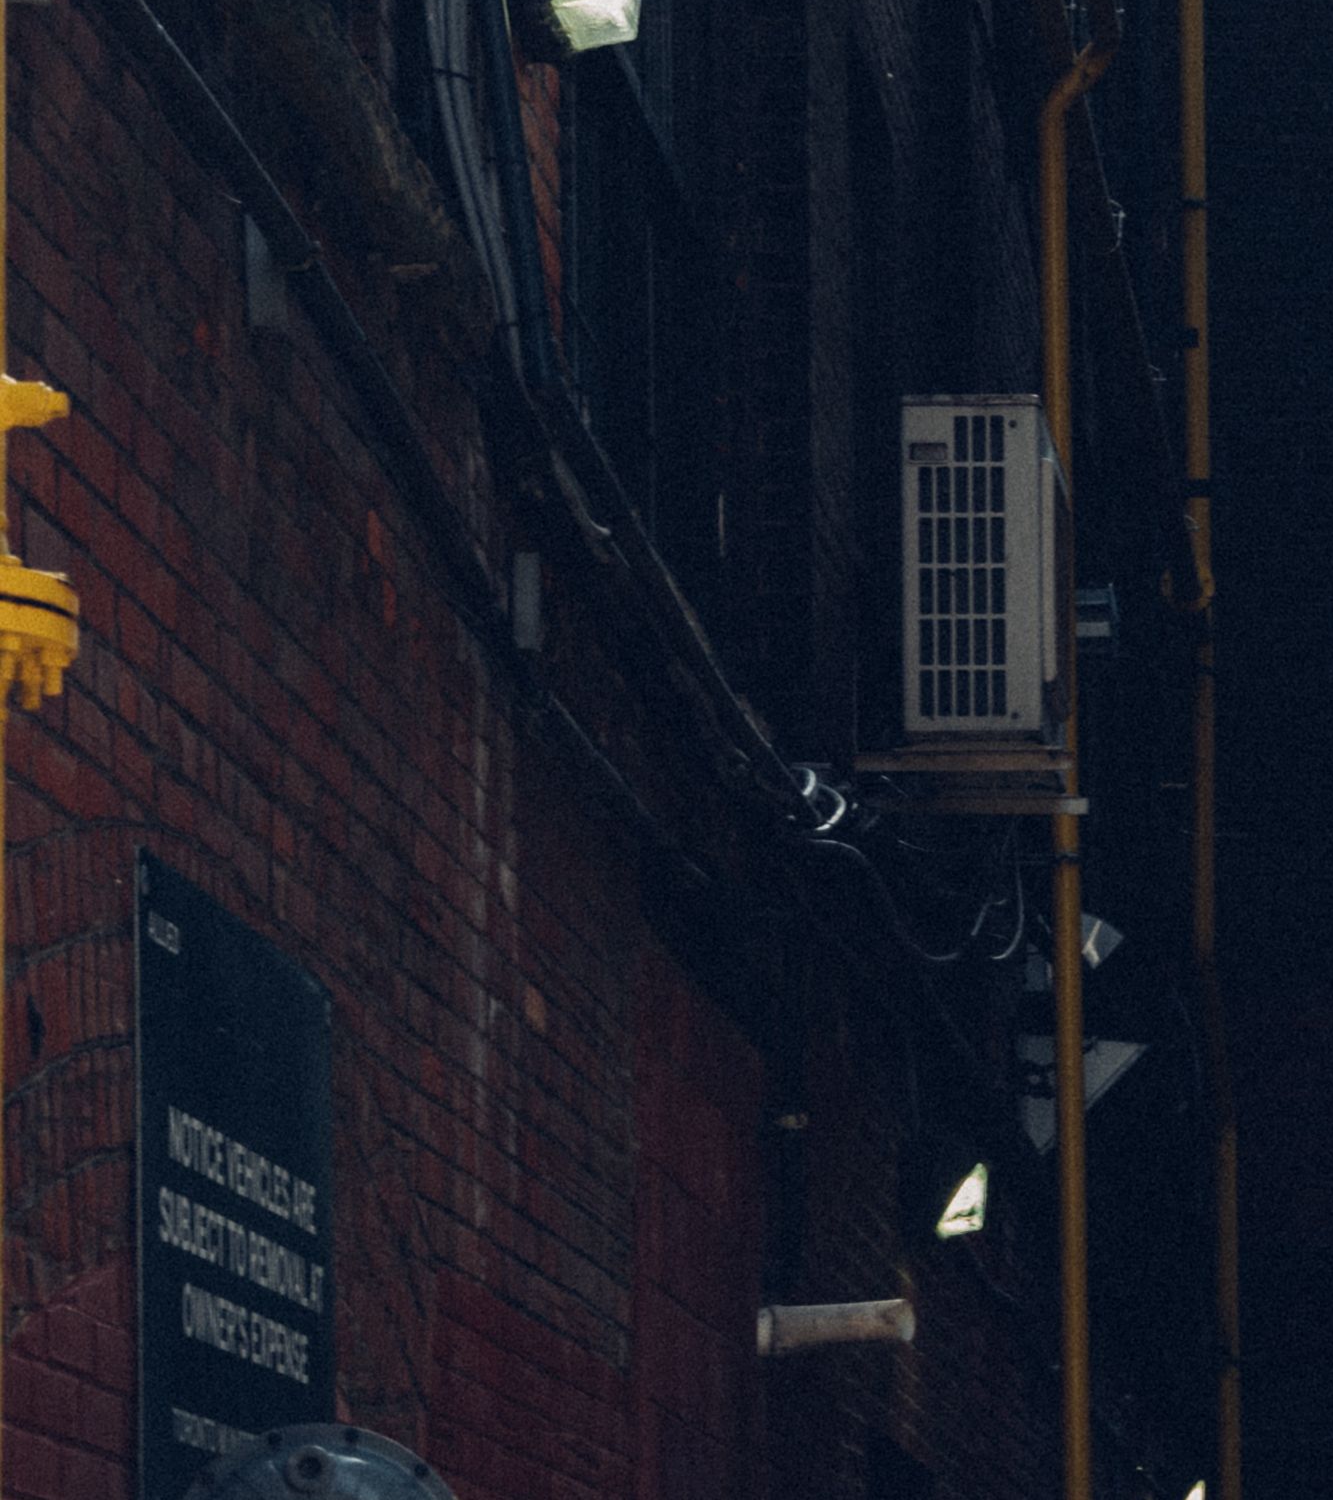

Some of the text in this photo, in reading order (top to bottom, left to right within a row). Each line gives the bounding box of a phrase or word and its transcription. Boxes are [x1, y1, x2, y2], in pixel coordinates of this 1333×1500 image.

[167, 1104, 317, 1235] NOTICE VEHICLES ARE
[158, 1185, 325, 1315] SUBJECT TO REMOVAL AT
[250, 1309, 309, 1385] EXPENSE
